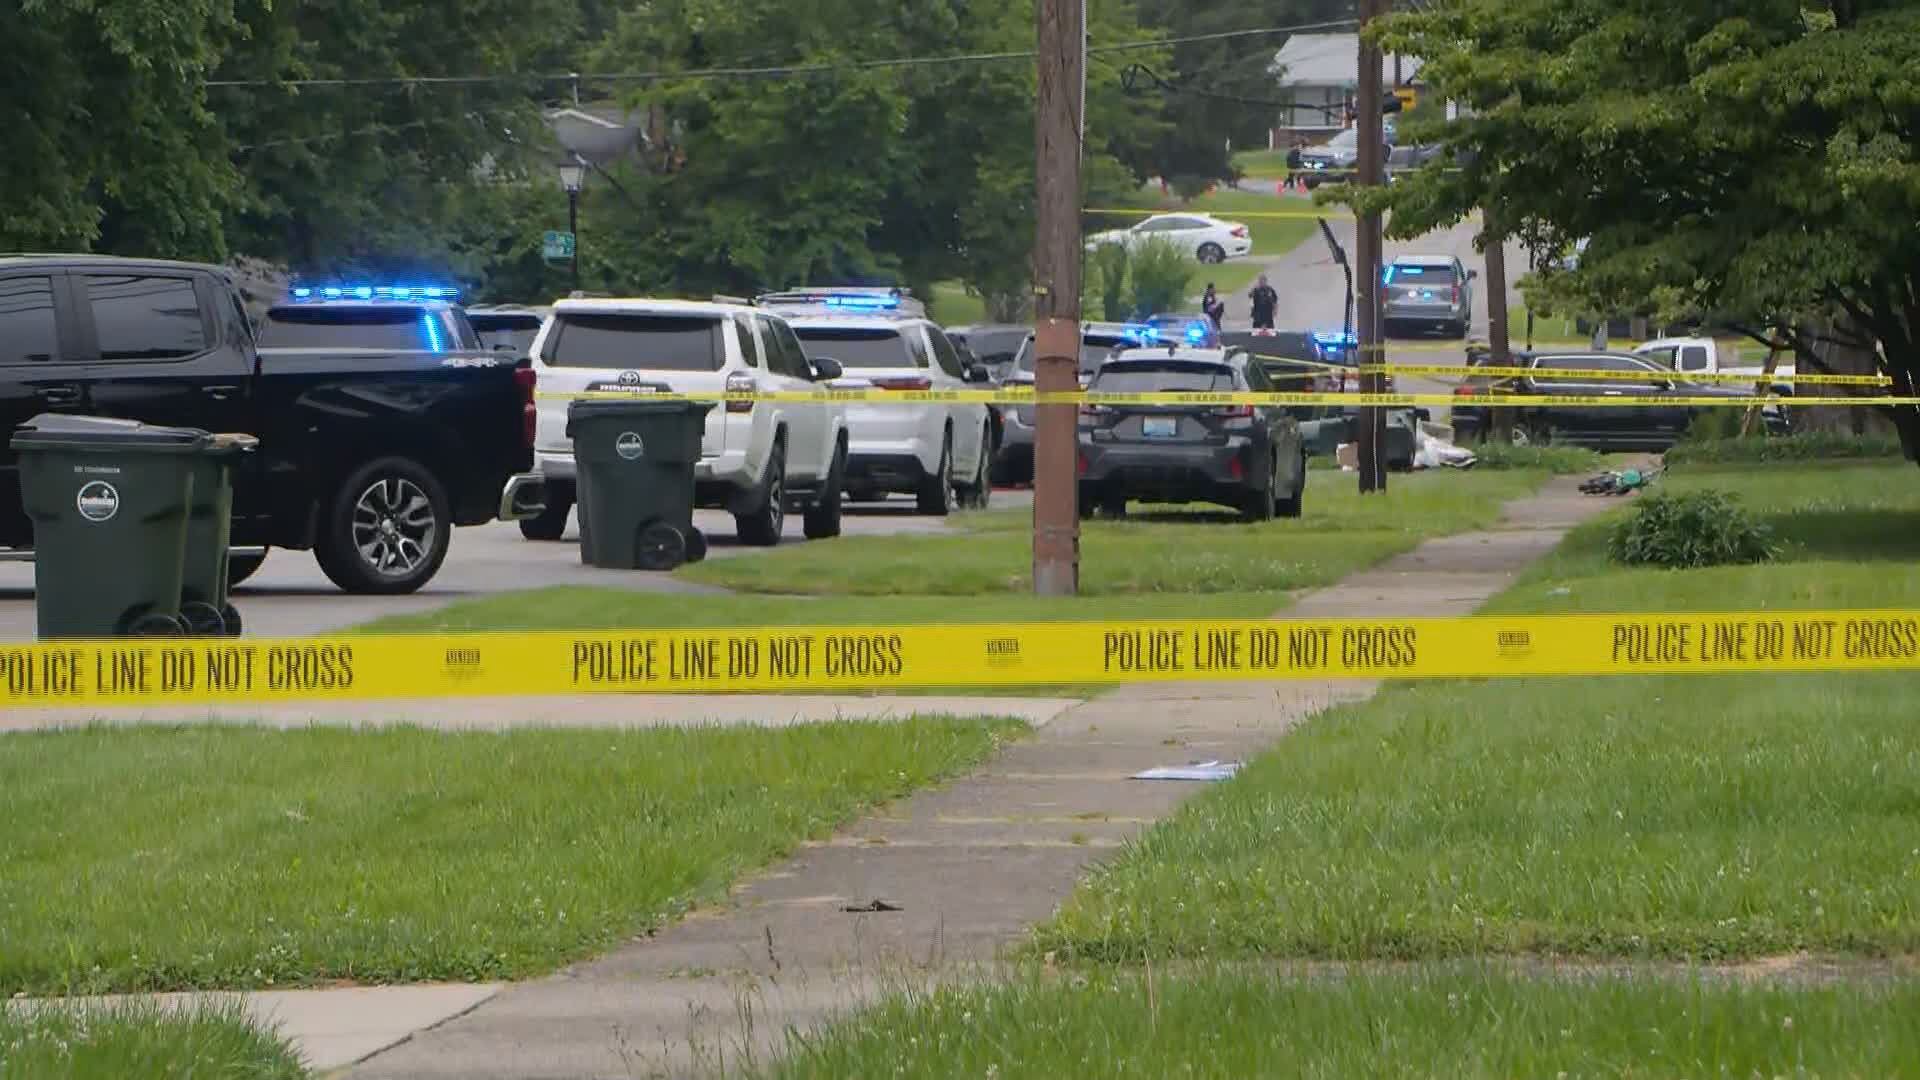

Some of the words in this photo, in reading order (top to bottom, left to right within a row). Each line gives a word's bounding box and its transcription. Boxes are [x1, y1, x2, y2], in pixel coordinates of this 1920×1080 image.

[573, 639, 657, 683] POLICE
[669, 638, 720, 680] LINE
[728, 637, 759, 678] DO
[769, 636, 815, 679] NOT
[824, 634, 903, 677] CROSS
[1103, 629, 1184, 671] POLICE
[1194, 629, 1241, 670] LINE
[1250, 627, 1279, 669] DO
[1288, 626, 1333, 669] NOT
[1341, 626, 1417, 667] CROSS
[1611, 623, 1691, 664] POLICE
[1700, 622, 1748, 662] LINE
[1754, 620, 1784, 661] DO
[1792, 620, 1836, 660] NOT
[1844, 618, 1918, 658] CROSS
[96, 648, 152, 694] LINE
[161, 648, 195, 693] DO
[206, 645, 256, 691] NOT
[267, 644, 353, 690] CROSS
